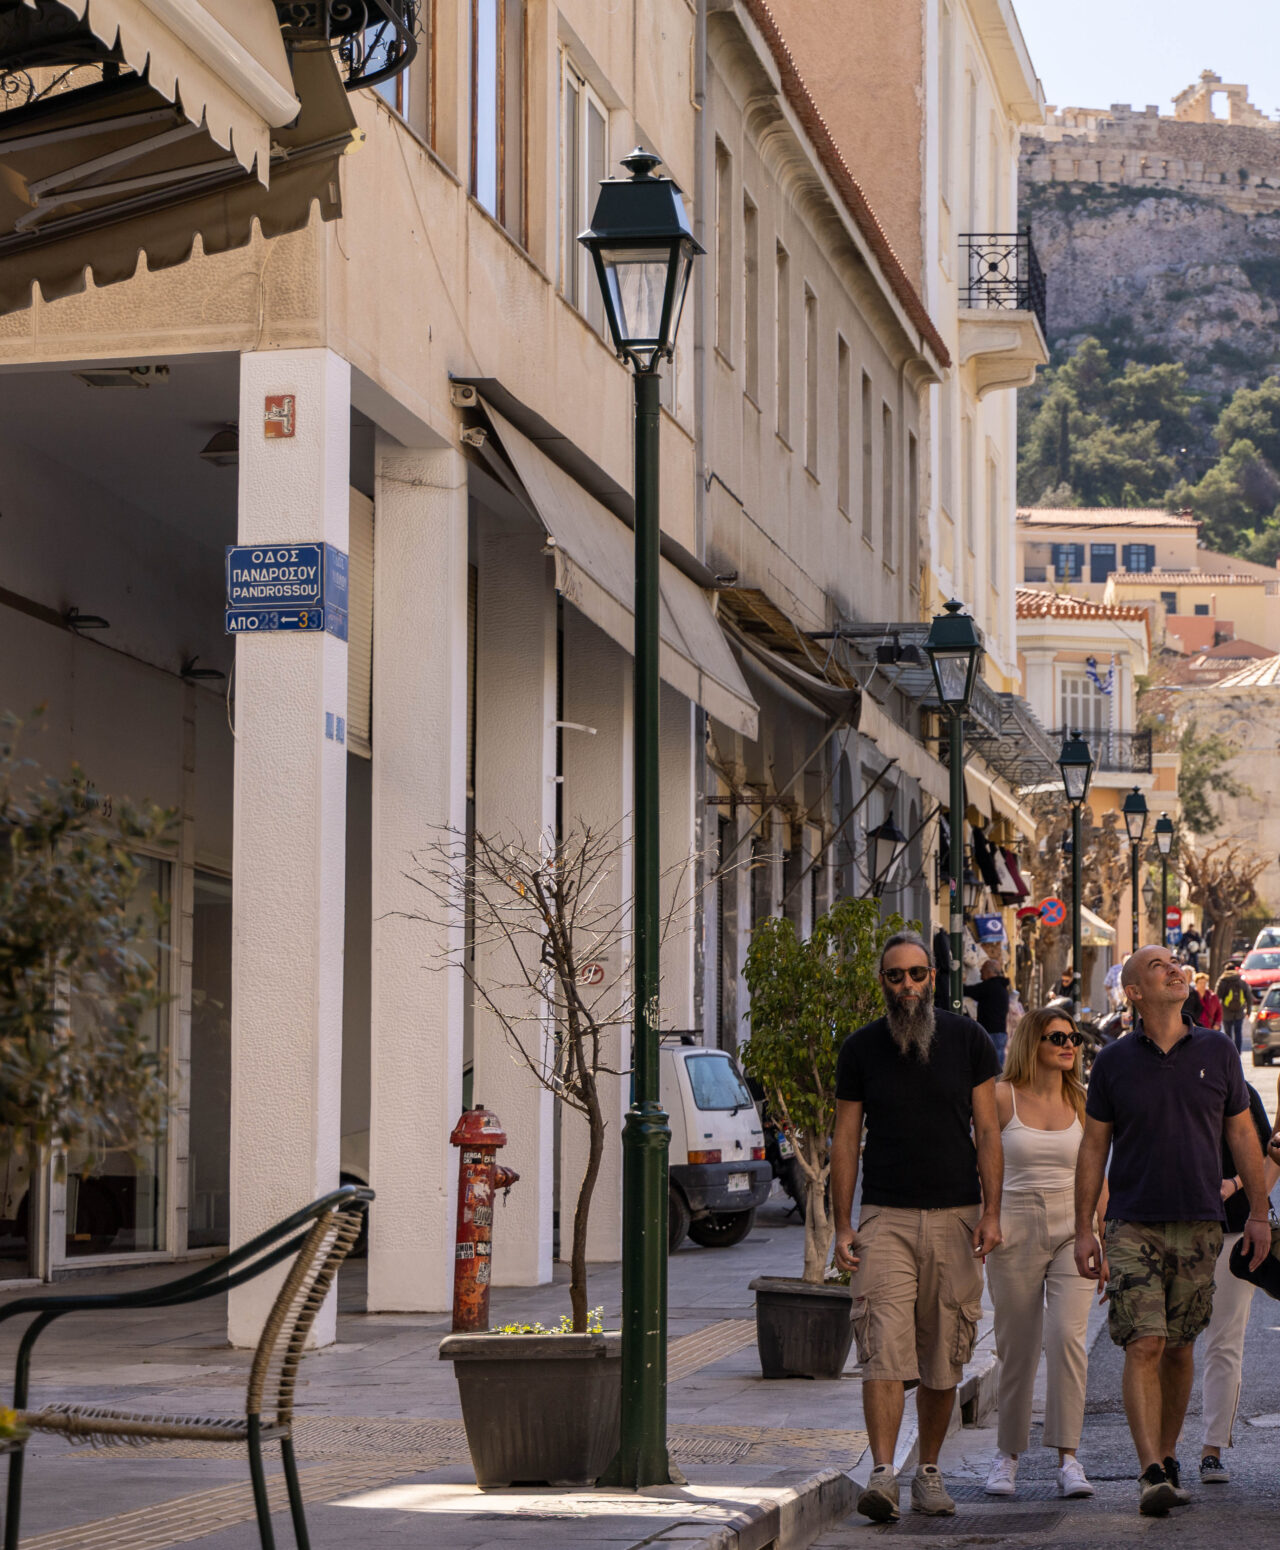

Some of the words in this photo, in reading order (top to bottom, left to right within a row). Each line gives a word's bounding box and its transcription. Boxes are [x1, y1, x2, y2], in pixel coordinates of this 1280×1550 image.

[251, 550, 299, 564] ΟΔΟΣ
[233, 566, 317, 583] ΠΑΝΔΡΟΣΟΥ
[232, 584, 318, 599] PANDROSSOU
[229, 616, 259, 630] ΑΠΟ
